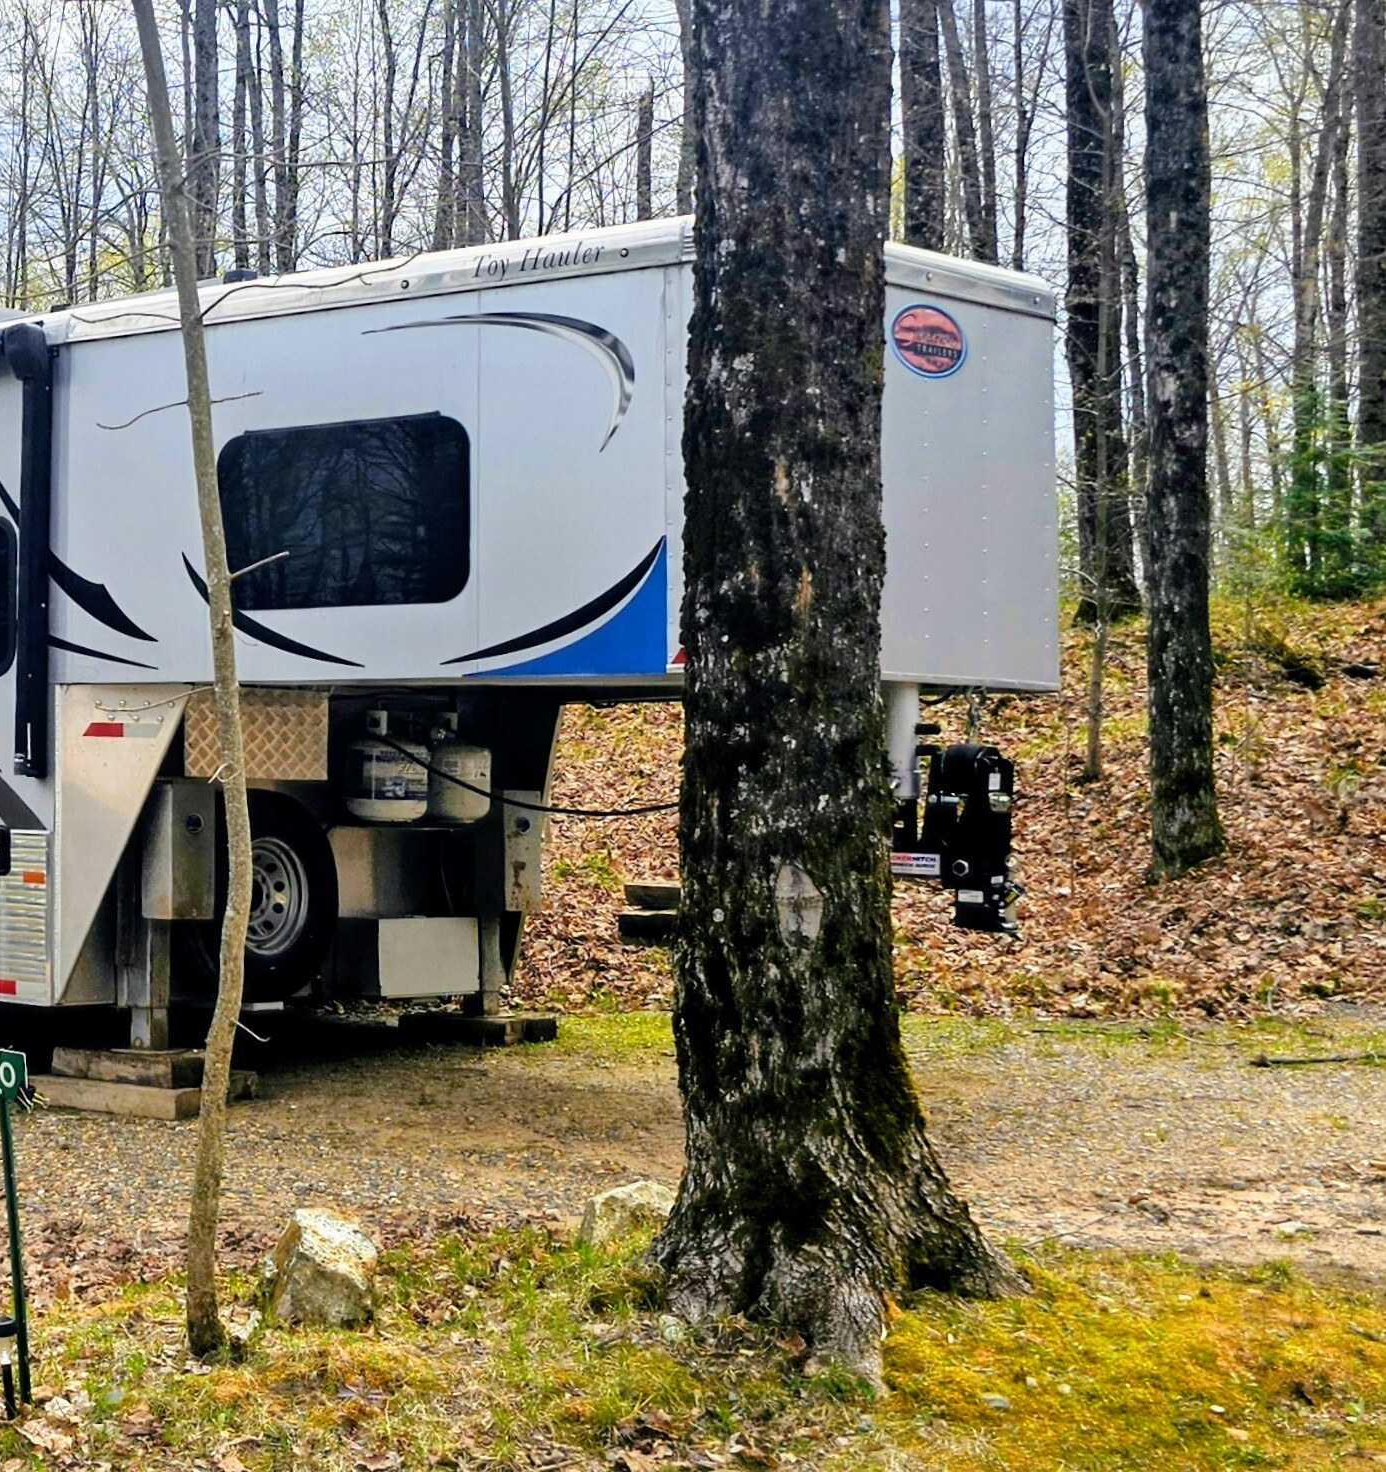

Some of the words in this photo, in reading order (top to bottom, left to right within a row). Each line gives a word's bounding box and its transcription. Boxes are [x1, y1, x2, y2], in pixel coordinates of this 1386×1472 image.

[473, 254, 509, 281] Toy
[519, 241, 605, 272] Hauler
[916, 343, 959, 359] TRAILERS
